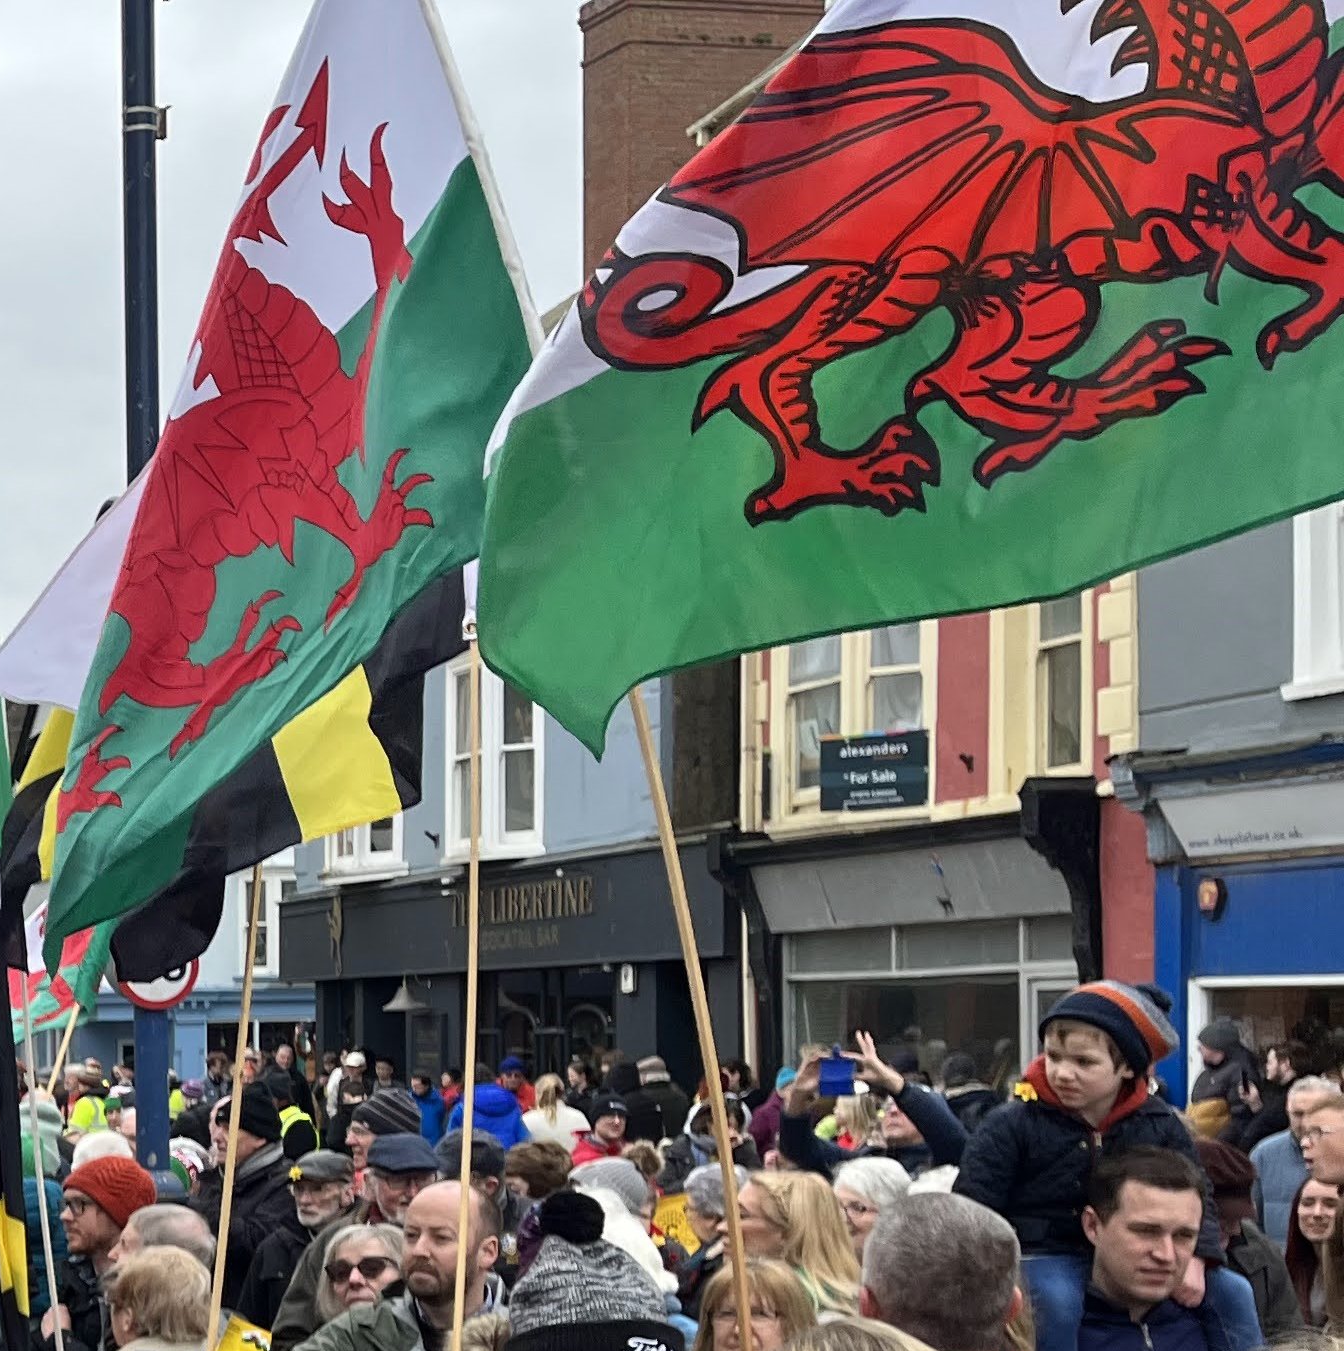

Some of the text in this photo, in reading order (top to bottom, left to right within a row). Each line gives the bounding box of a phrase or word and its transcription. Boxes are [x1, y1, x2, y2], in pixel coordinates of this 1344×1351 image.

[839, 742, 909, 759] alexanders
[850, 769, 898, 785] For Sale
[490, 876, 593, 925] LIBERTINE
[536, 924, 560, 947] BAR
